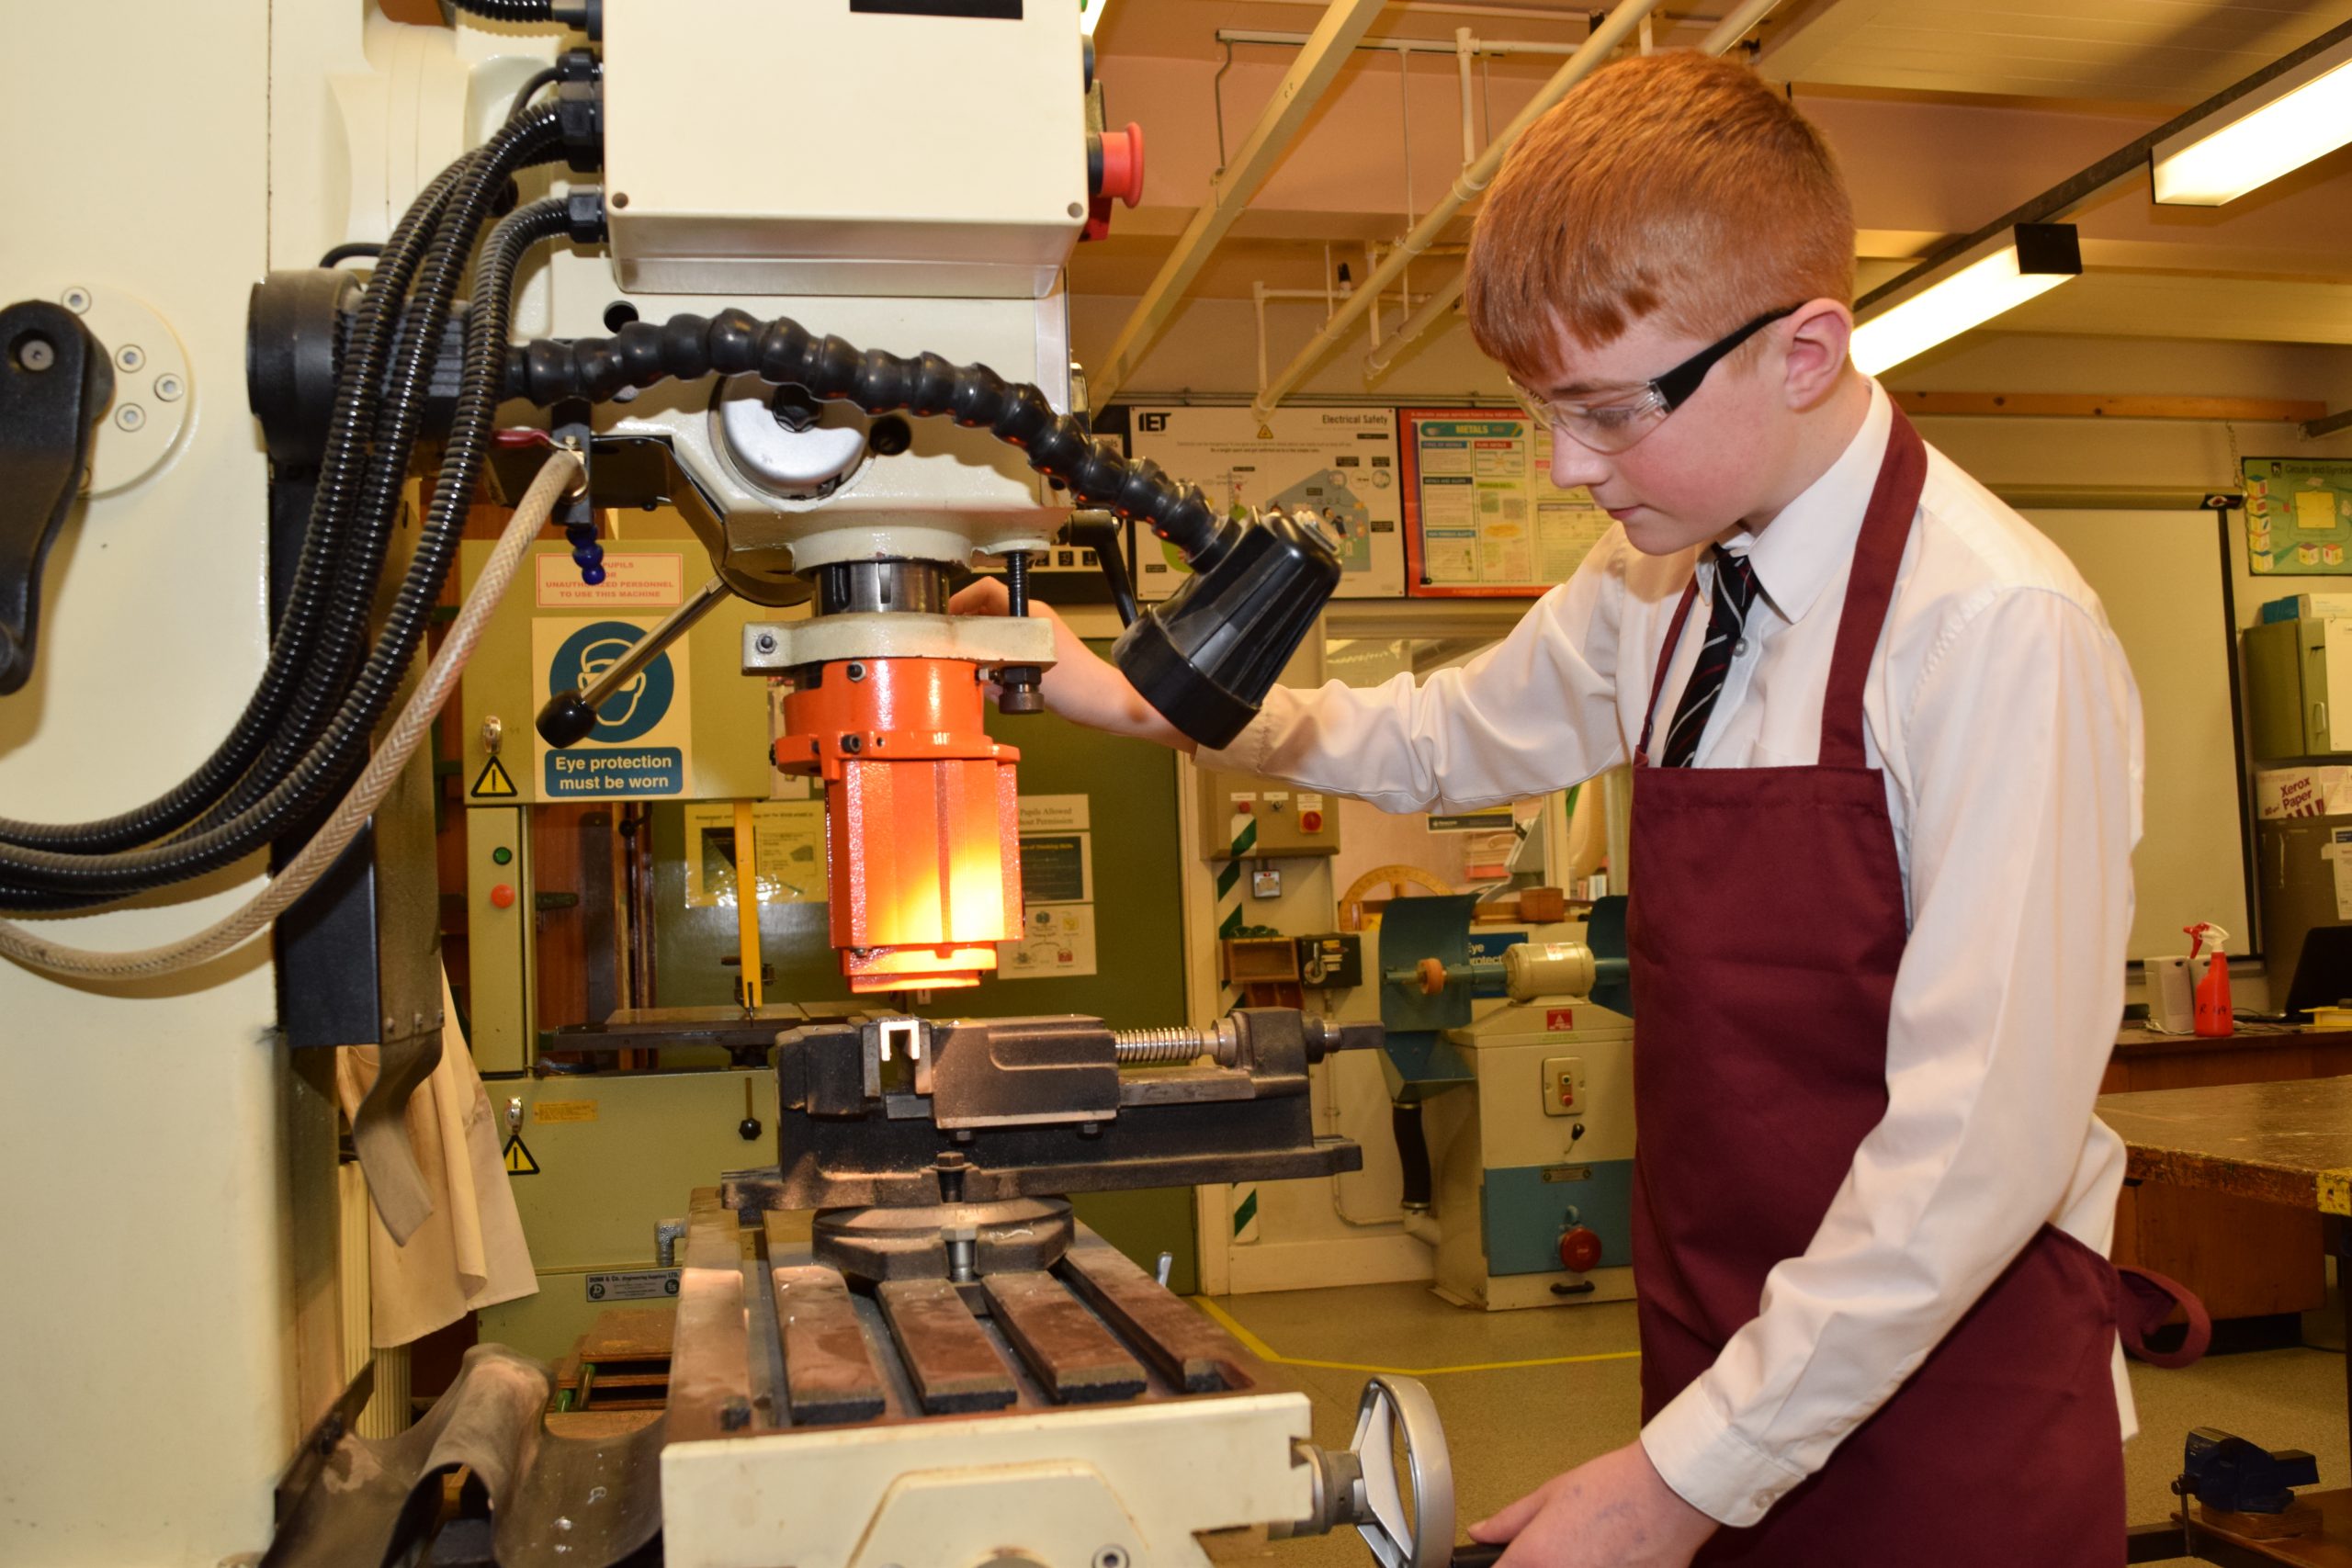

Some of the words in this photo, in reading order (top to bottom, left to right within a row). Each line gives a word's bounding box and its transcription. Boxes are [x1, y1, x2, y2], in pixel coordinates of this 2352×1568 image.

[1138, 412, 1171, 432] IET
[1322, 414, 1361, 424] Electrical
[1363, 414, 1388, 426] Safety
[1455, 424, 1488, 434] METALS
[2312, 464, 2324, 473] and
[556, 756, 585, 773] Eye
[590, 755, 672, 772] protection
[560, 776, 600, 790] must
[605, 775, 624, 789] be
[628, 776, 668, 788] worn
[2280, 777, 2310, 797] Xerox
[2282, 790, 2312, 810] Paper
[1044, 807, 1072, 816] Allowed
[2199, 1004, 2207, 1015] R
